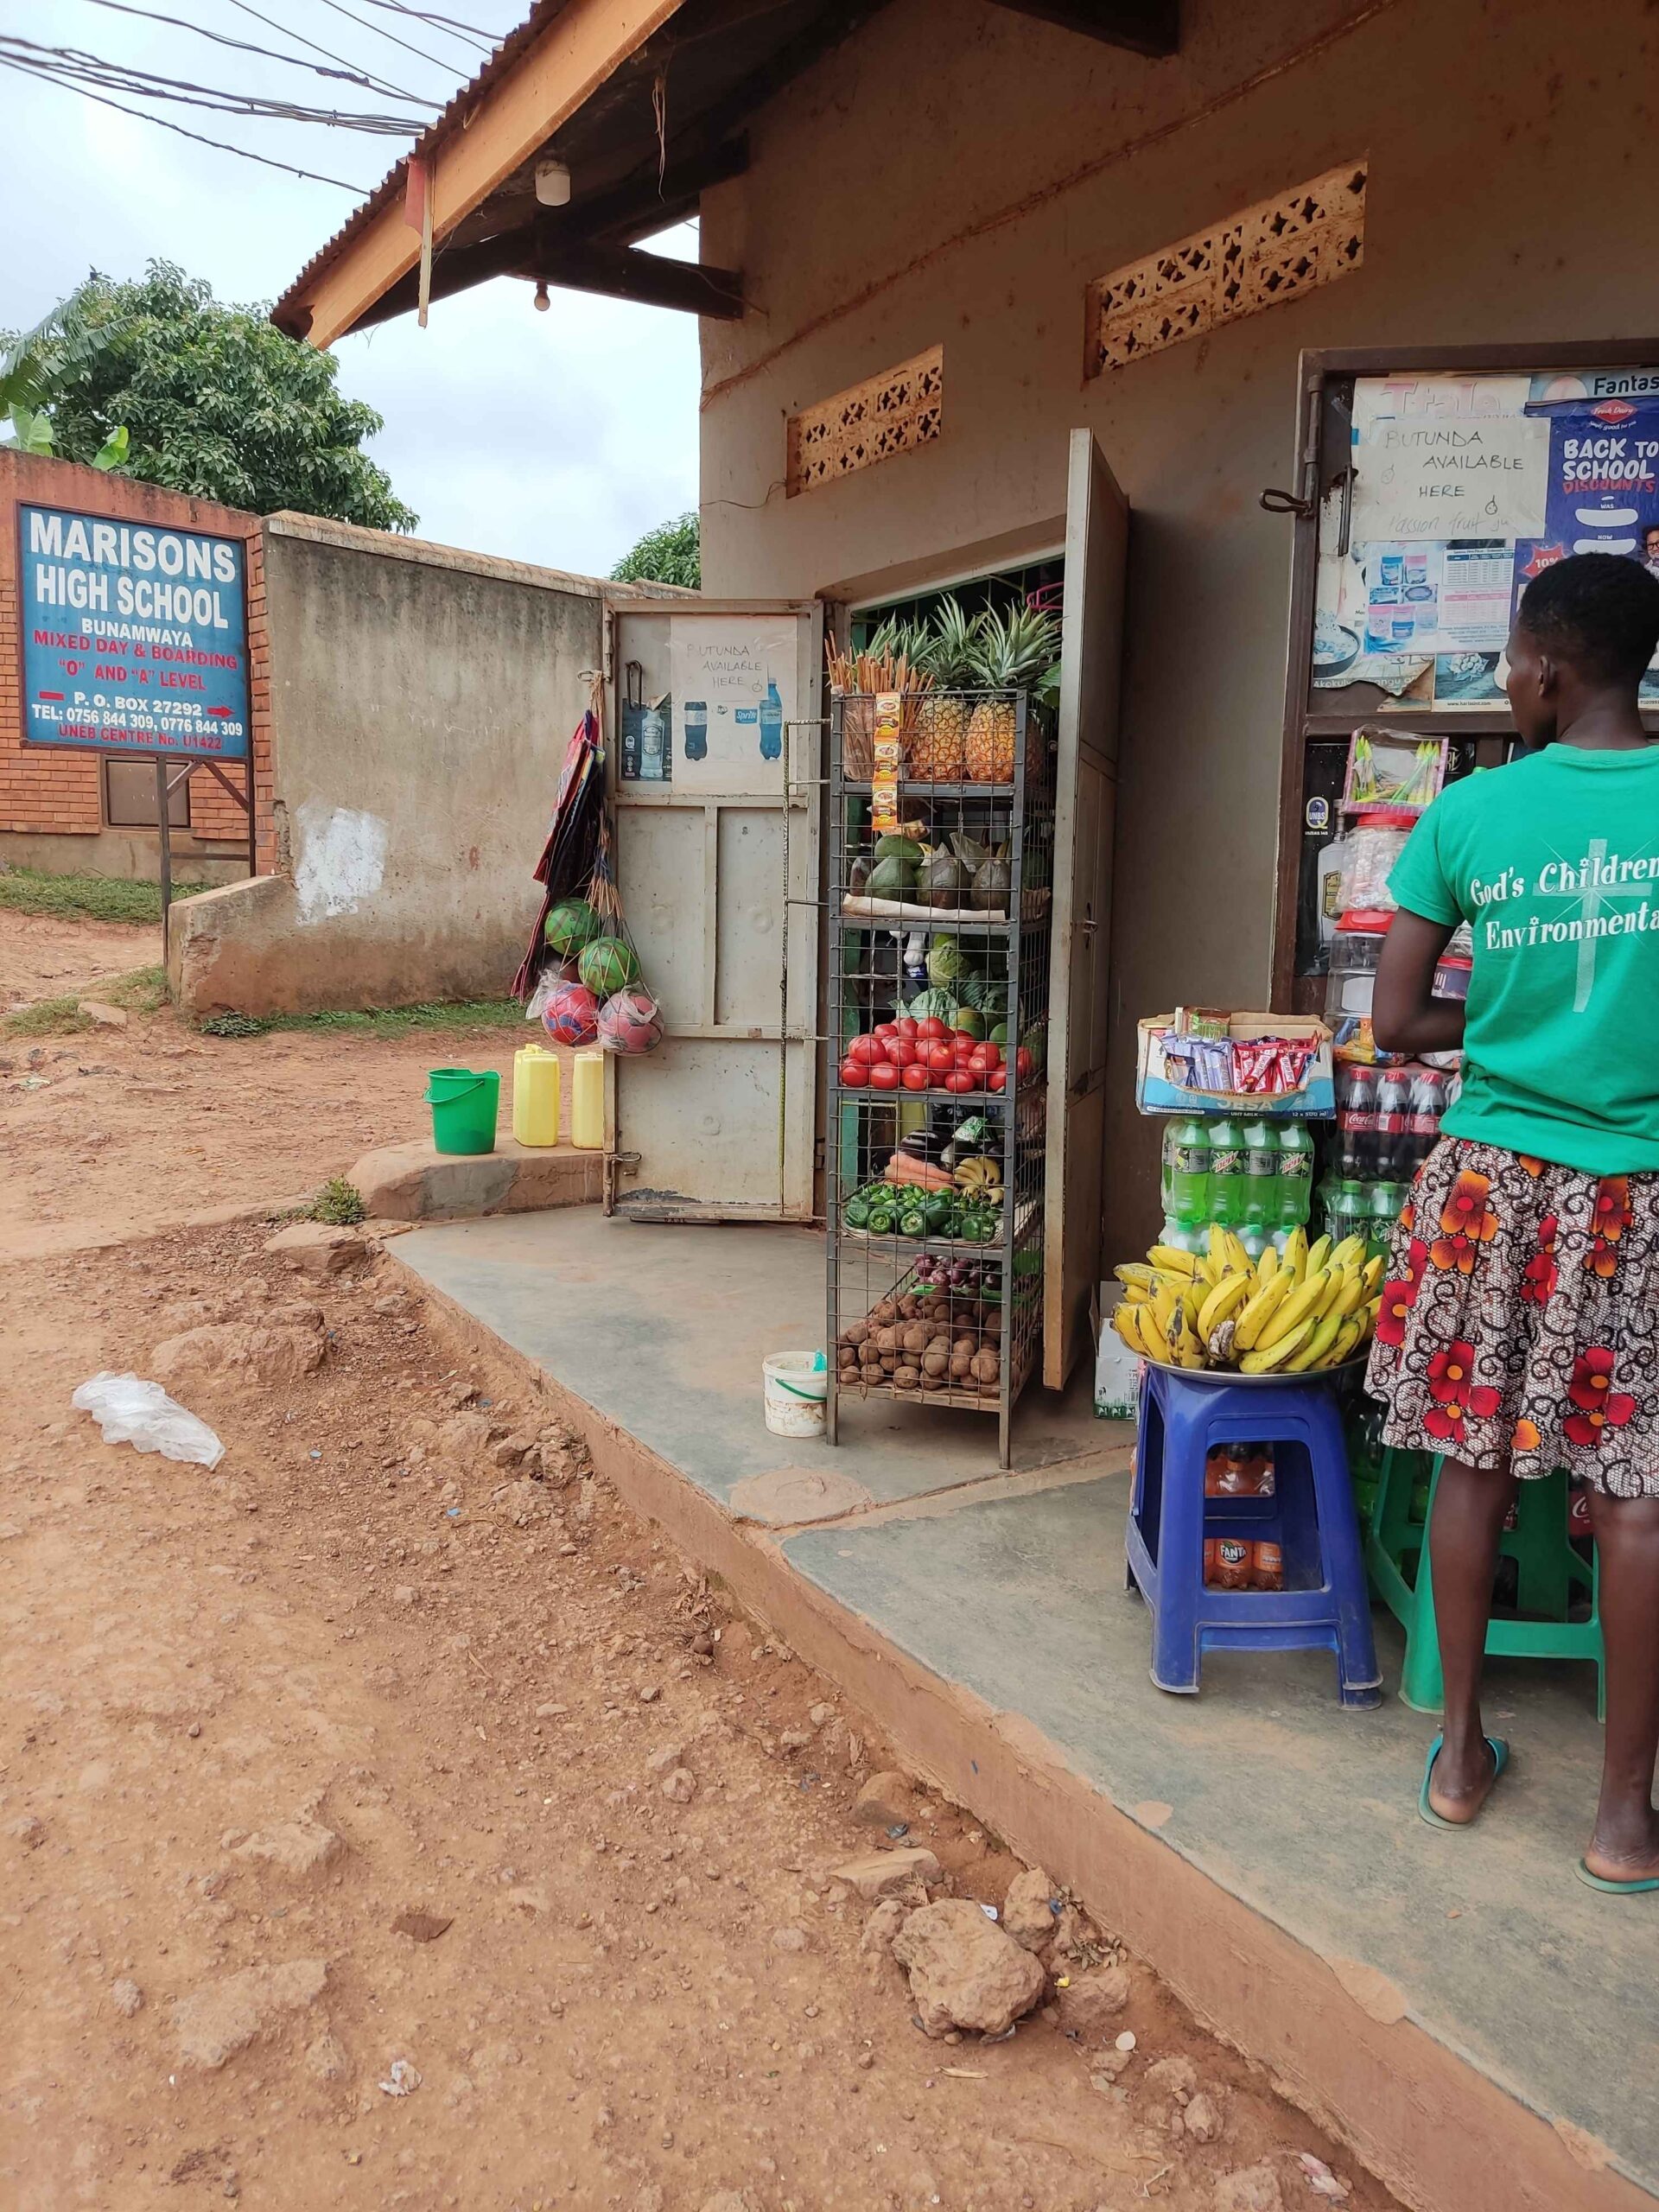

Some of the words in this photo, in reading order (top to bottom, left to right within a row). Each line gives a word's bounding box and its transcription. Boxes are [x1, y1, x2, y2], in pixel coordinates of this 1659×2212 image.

[1593, 375, 1659, 396] Fantas
[1385, 430, 1484, 448] BUTUNDA
[1563, 437, 1628, 460] BACK
[1634, 441, 1659, 459] TO
[1422, 454, 1524, 470] AVAILABLE
[1562, 459, 1656, 481] SCHOOL
[1419, 485, 1465, 499] HERE
[1562, 478, 1656, 495] DISCOUNTS
[30, 512, 237, 582] MARISONS
[36, 563, 108, 612] HIGH
[118, 579, 229, 629] SCHOOL
[82, 618, 194, 648] BUNAMWAYA
[34, 629, 91, 652] MIXED
[96, 638, 129, 657] DAY
[133, 643, 147, 658] &
[152, 645, 238, 670] BOARDING
[94, 664, 128, 683] AND
[160, 671, 207, 690] LEVEL
[702, 660, 762, 672] AVAILABLE
[712, 677, 745, 689] HERE
[74, 691, 90, 706] P.
[93, 694, 111, 709] O.
[115, 696, 149, 711] BOX
[152, 700, 203, 716] 27292
[31, 703, 63, 721] TEL:
[67, 706, 99, 724] 0756
[102, 710, 128, 727] 844
[130, 713, 158, 733] 309,
[161, 715, 193, 733] 0776
[195, 718, 219, 734] 844
[221, 721, 244, 736] 309
[59, 723, 97, 740] UNEB
[101, 728, 154, 745] CENTRE
[158, 731, 180, 747] No.
[1471, 867, 1524, 907] God's
[1538, 853, 1659, 893] Children
[1485, 903, 1659, 950] Environmenta
[1217, 1098, 1274, 1111] JESA
[1220, 1545, 1247, 1558] FANTA
